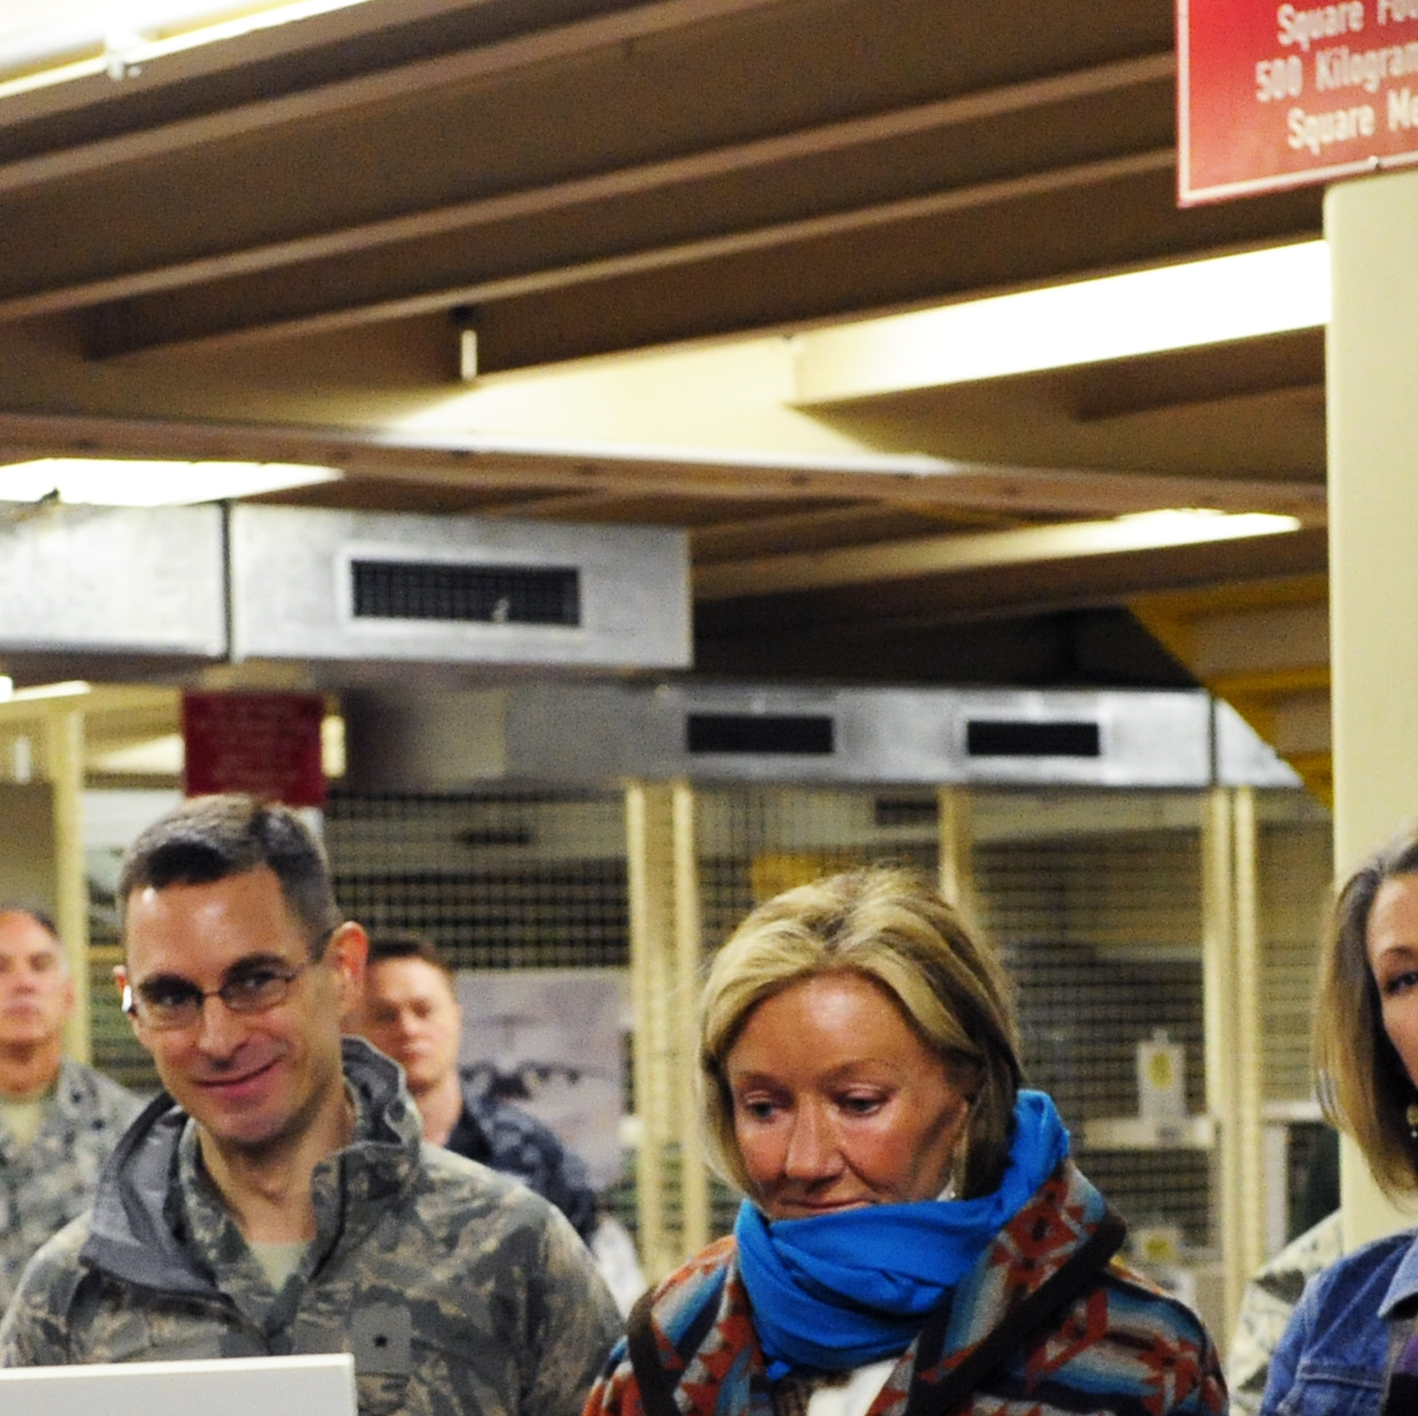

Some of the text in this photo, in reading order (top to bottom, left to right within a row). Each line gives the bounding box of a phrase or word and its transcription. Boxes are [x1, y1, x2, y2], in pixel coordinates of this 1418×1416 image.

[1277, 1, 1364, 51] Square
[1255, 55, 1303, 103] 500
[1287, 105, 1376, 156] Square
